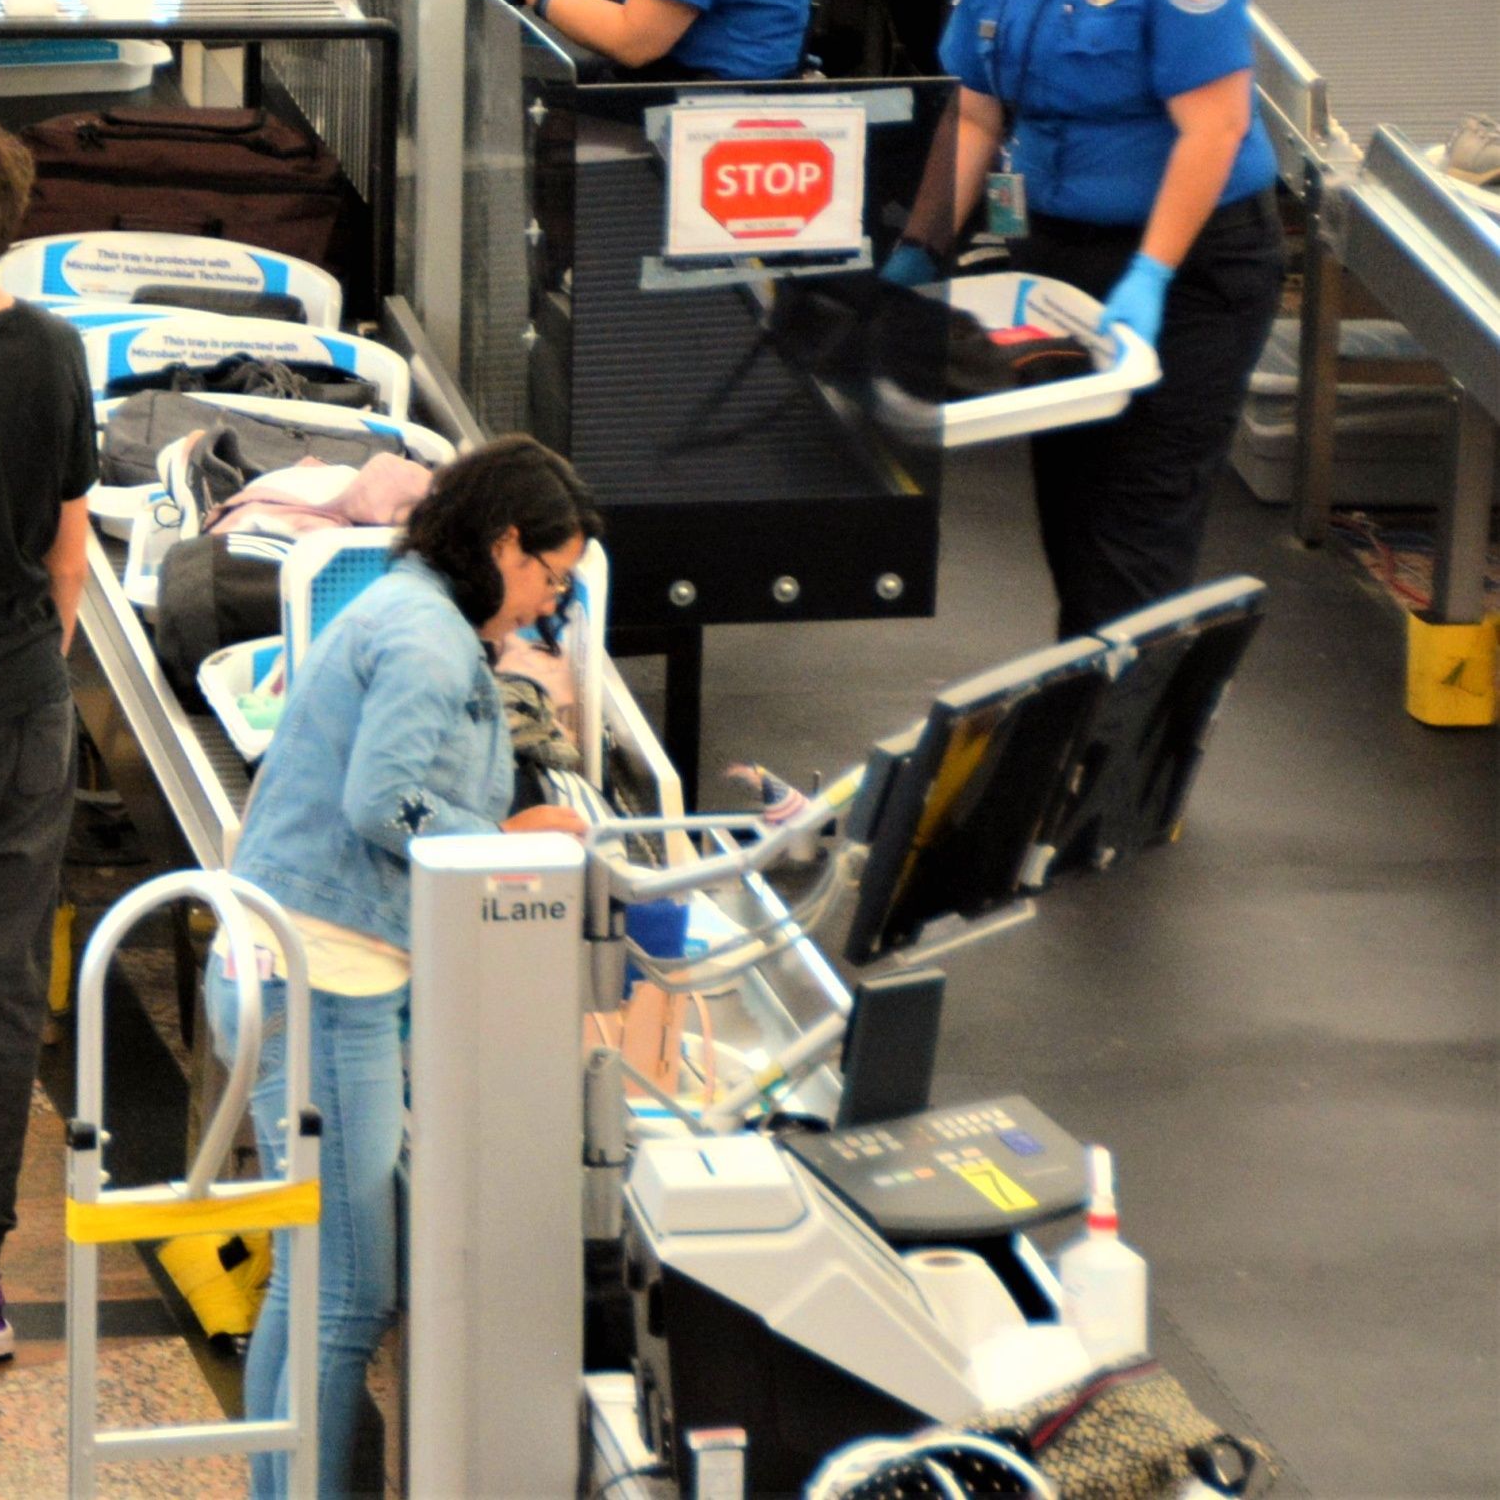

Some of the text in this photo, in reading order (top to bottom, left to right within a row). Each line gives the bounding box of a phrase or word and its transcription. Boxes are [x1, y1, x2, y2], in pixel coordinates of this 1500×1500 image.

[715, 161, 823, 198] STOP
[97, 248, 231, 269] This tray is protected with
[123, 265, 196, 280] Antimicrobial
[198, 269, 259, 286] Technology
[163, 335, 299, 353] This tray is protected with
[481, 896, 567, 922] iLane
